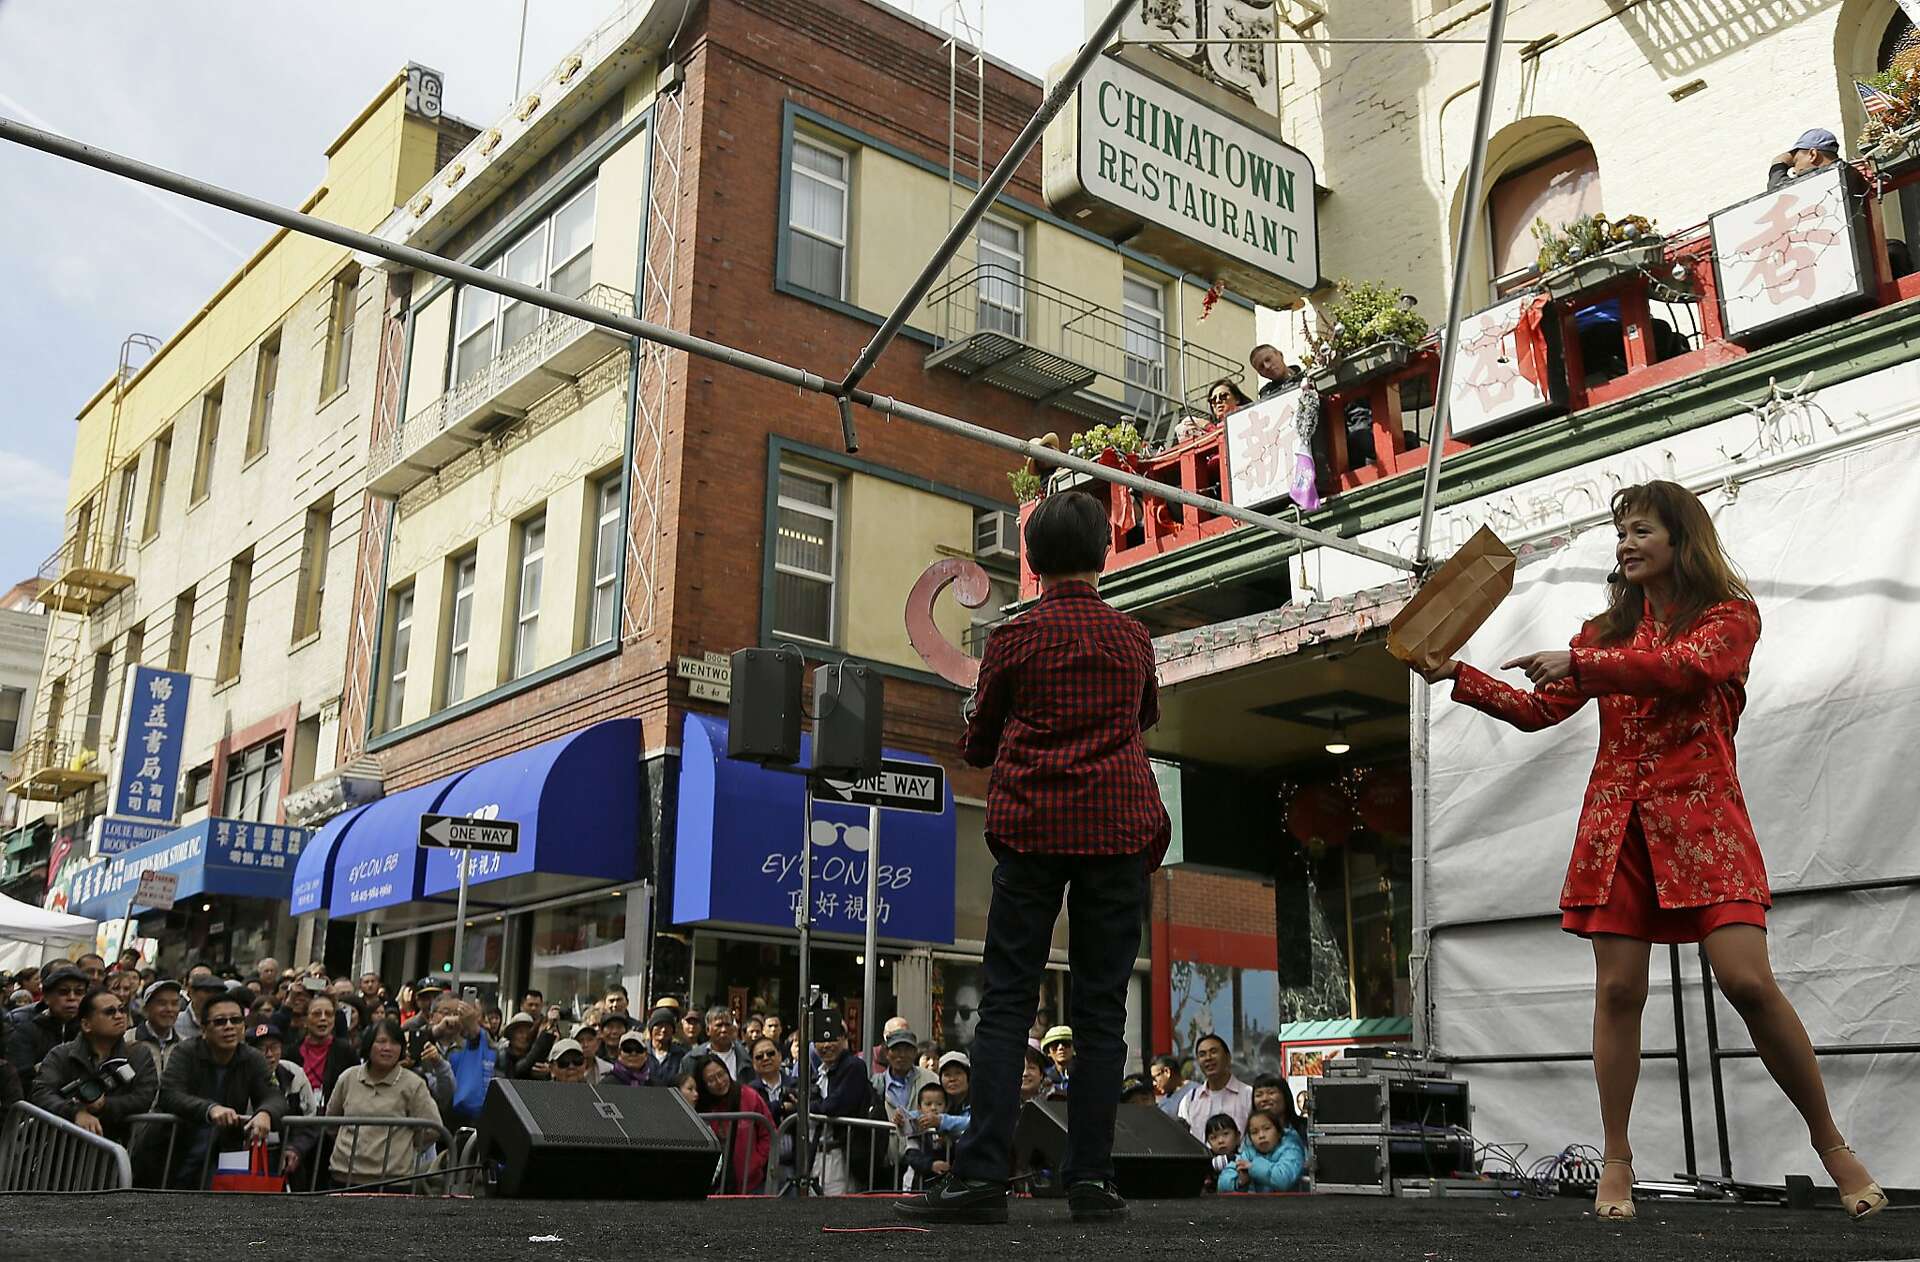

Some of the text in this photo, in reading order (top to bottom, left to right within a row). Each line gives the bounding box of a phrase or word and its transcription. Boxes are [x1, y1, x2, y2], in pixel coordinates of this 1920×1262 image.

[1098, 80, 1297, 213] CHINATOWN
[1098, 139, 1299, 263] RESTAURANT
[1736, 193, 1842, 305] 香
[681, 661, 729, 680] WENTWO
[894, 775, 930, 797] WAY
[449, 826, 508, 843] ONE WAY
